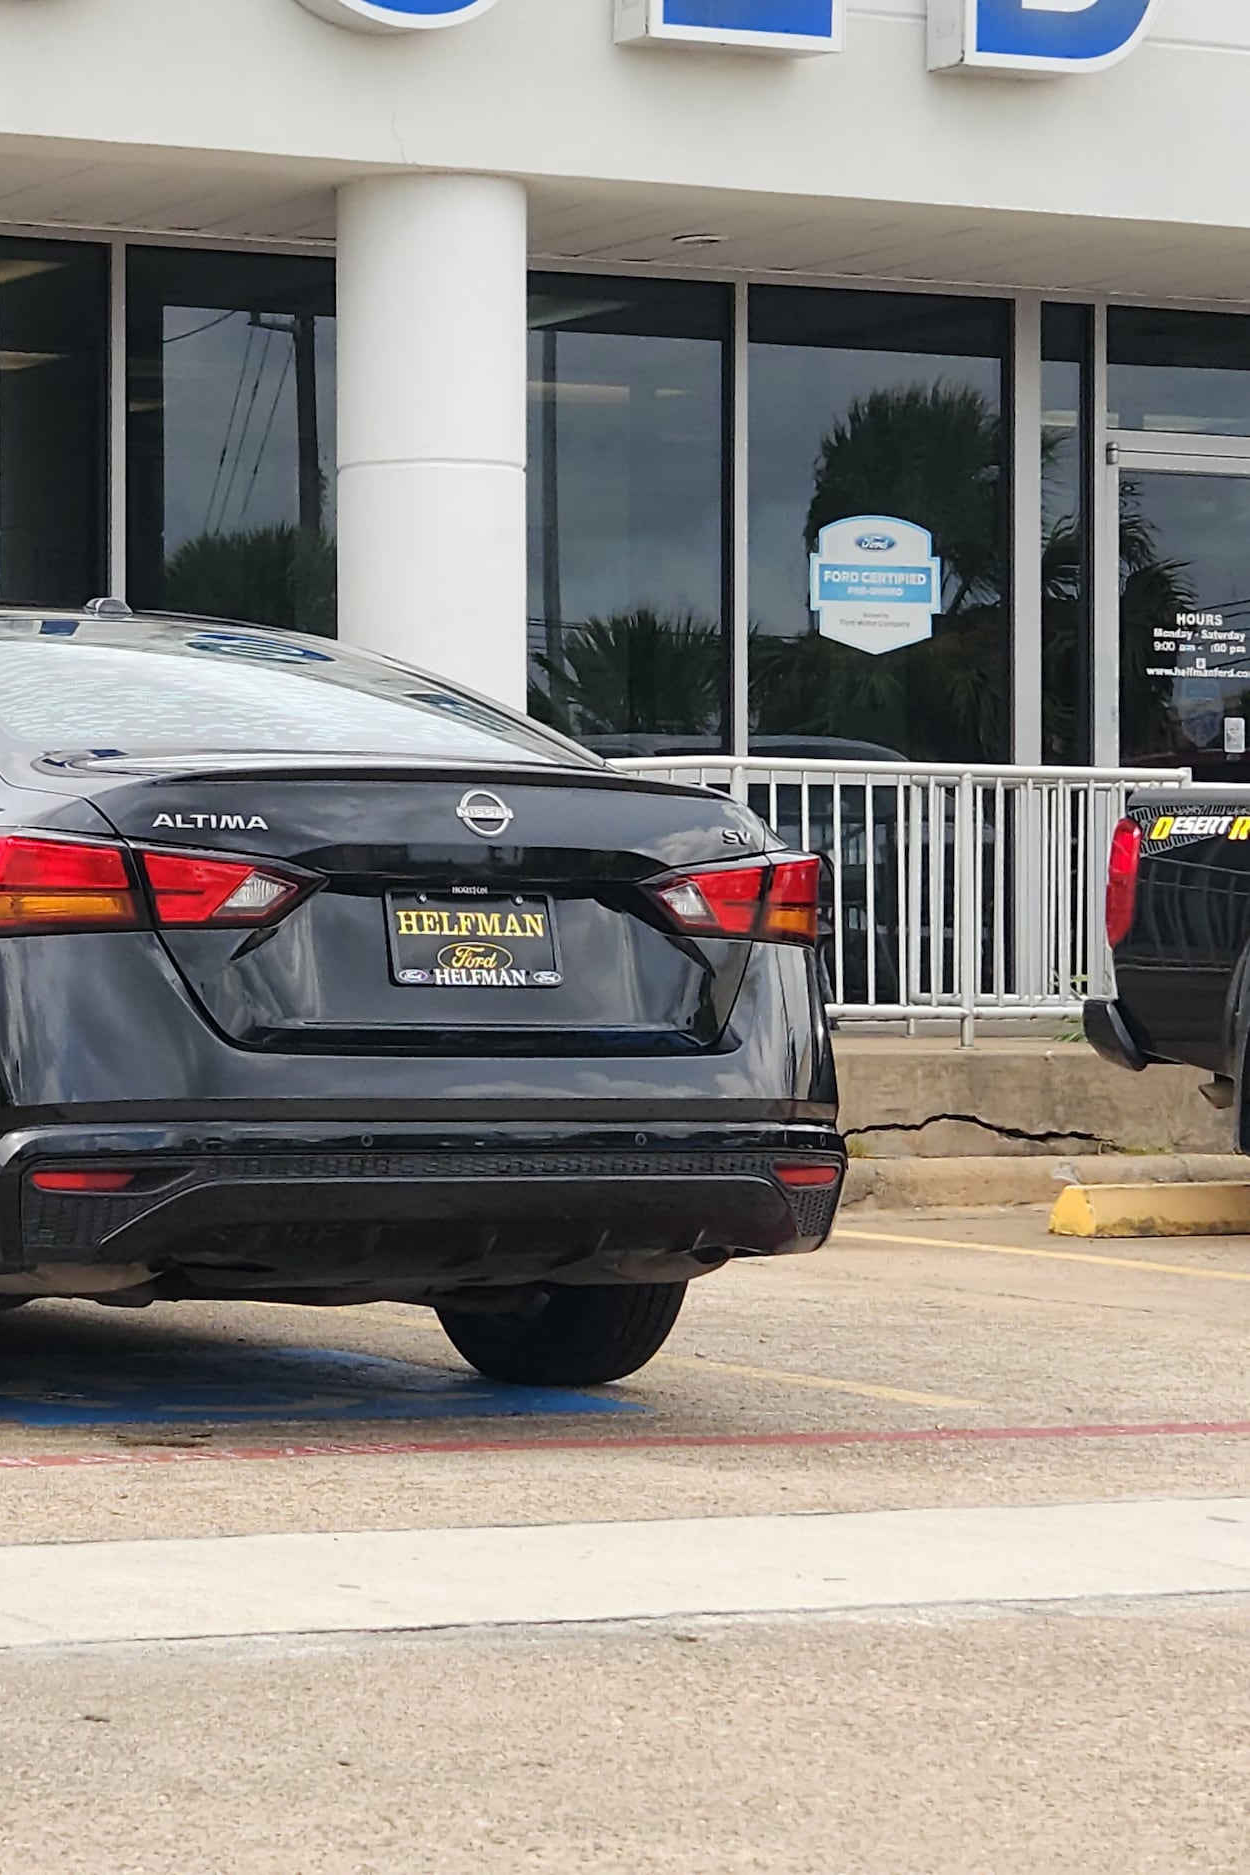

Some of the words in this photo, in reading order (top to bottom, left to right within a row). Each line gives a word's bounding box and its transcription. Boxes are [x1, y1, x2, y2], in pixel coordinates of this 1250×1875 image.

[823, 570, 859, 583] FORD
[861, 572, 926, 585] CERTIFIED
[1176, 613, 1223, 626] HOURS
[1153, 628, 1192, 641] Monday
[1201, 629, 1246, 643] Saturday
[1153, 641, 1175, 652] 9:00
[1146, 666, 1250, 678] www.helfmanford.co
[460, 807, 510, 818] NISSAN
[151, 813, 269, 830] ALTIMA
[1150, 816, 1234, 840] DESERT
[721, 829, 752, 845] SV
[396, 911, 545, 937] HELFMAN
[452, 946, 498, 969] Ford
[433, 969, 527, 986] HELFMAN
